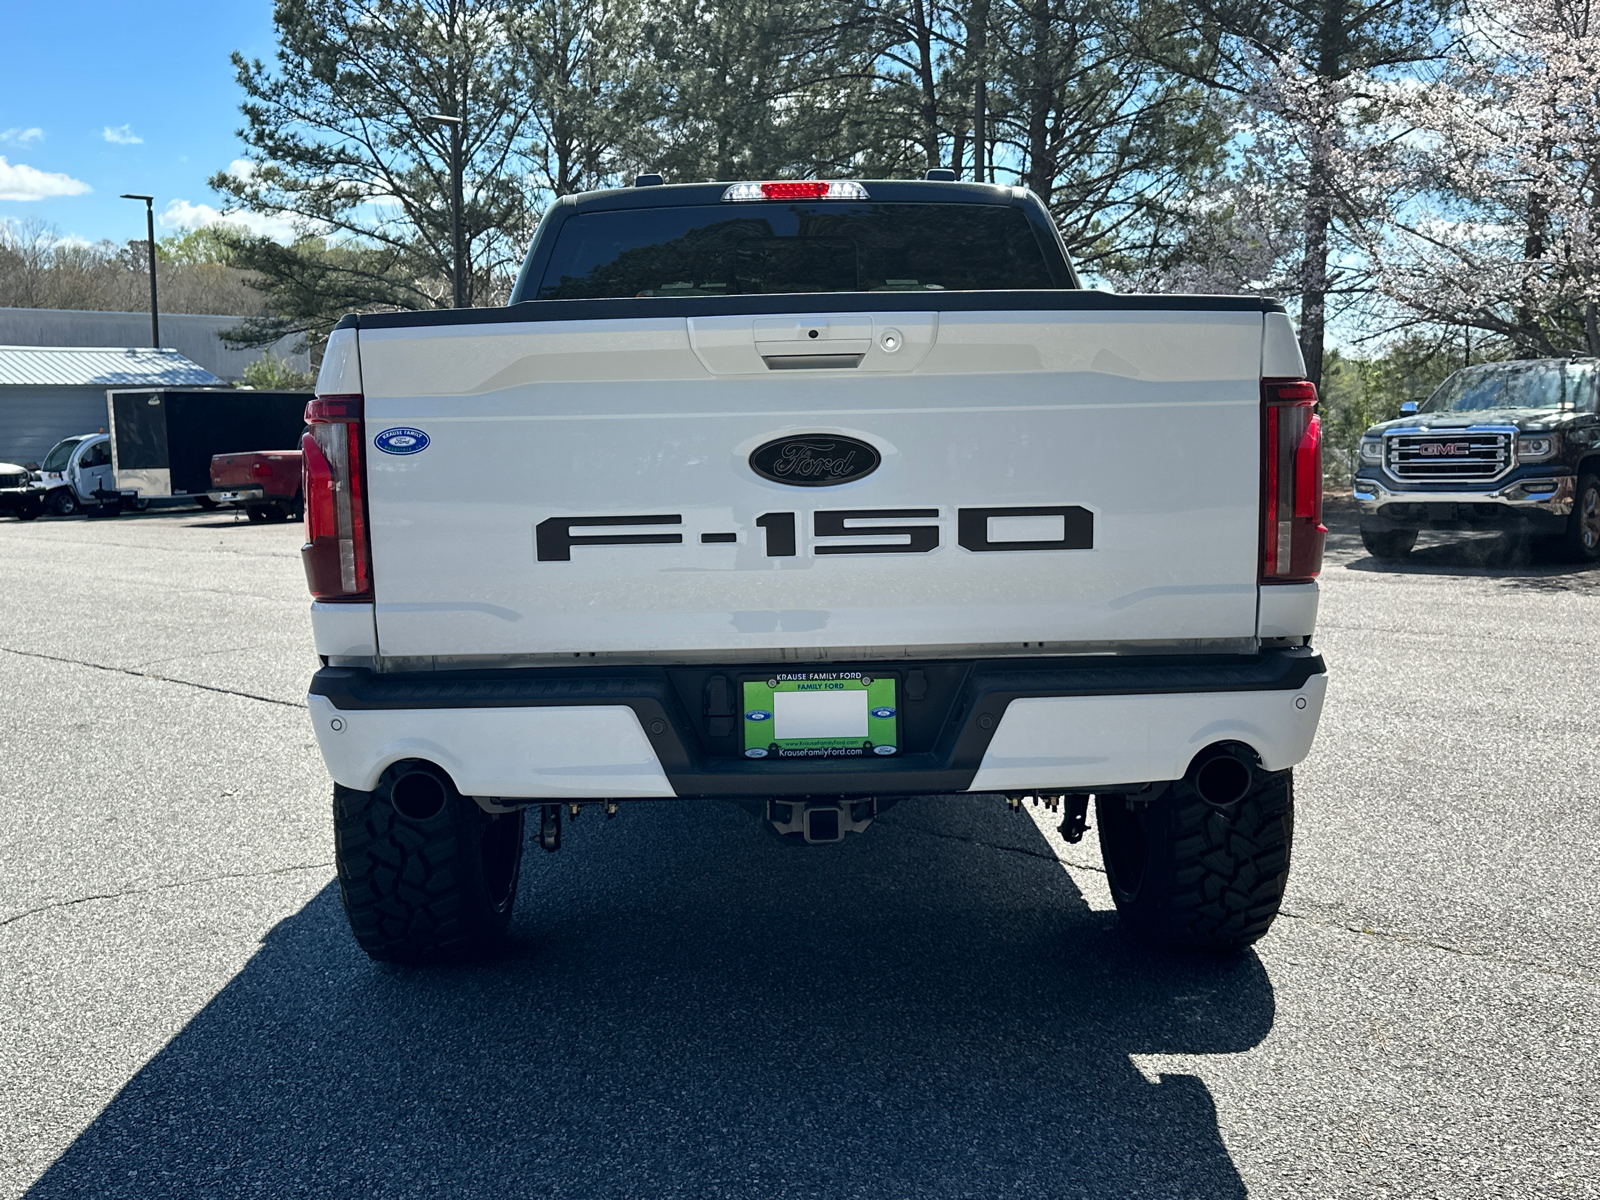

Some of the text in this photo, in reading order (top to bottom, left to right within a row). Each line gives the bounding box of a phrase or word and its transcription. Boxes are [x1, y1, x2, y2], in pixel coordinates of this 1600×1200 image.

[382, 430, 422, 439] KRAUSE FAMILY
[394, 437, 411, 445] Ford
[1419, 442, 1470, 455] GMC
[773, 443, 856, 476] Ford
[535, 505, 1095, 563] F-150
[776, 673, 807, 681] KRAUSE
[809, 672, 837, 680] FAMILY
[824, 682, 845, 690] FORD
[778, 747, 863, 758] KrauseFamilyFord.com
